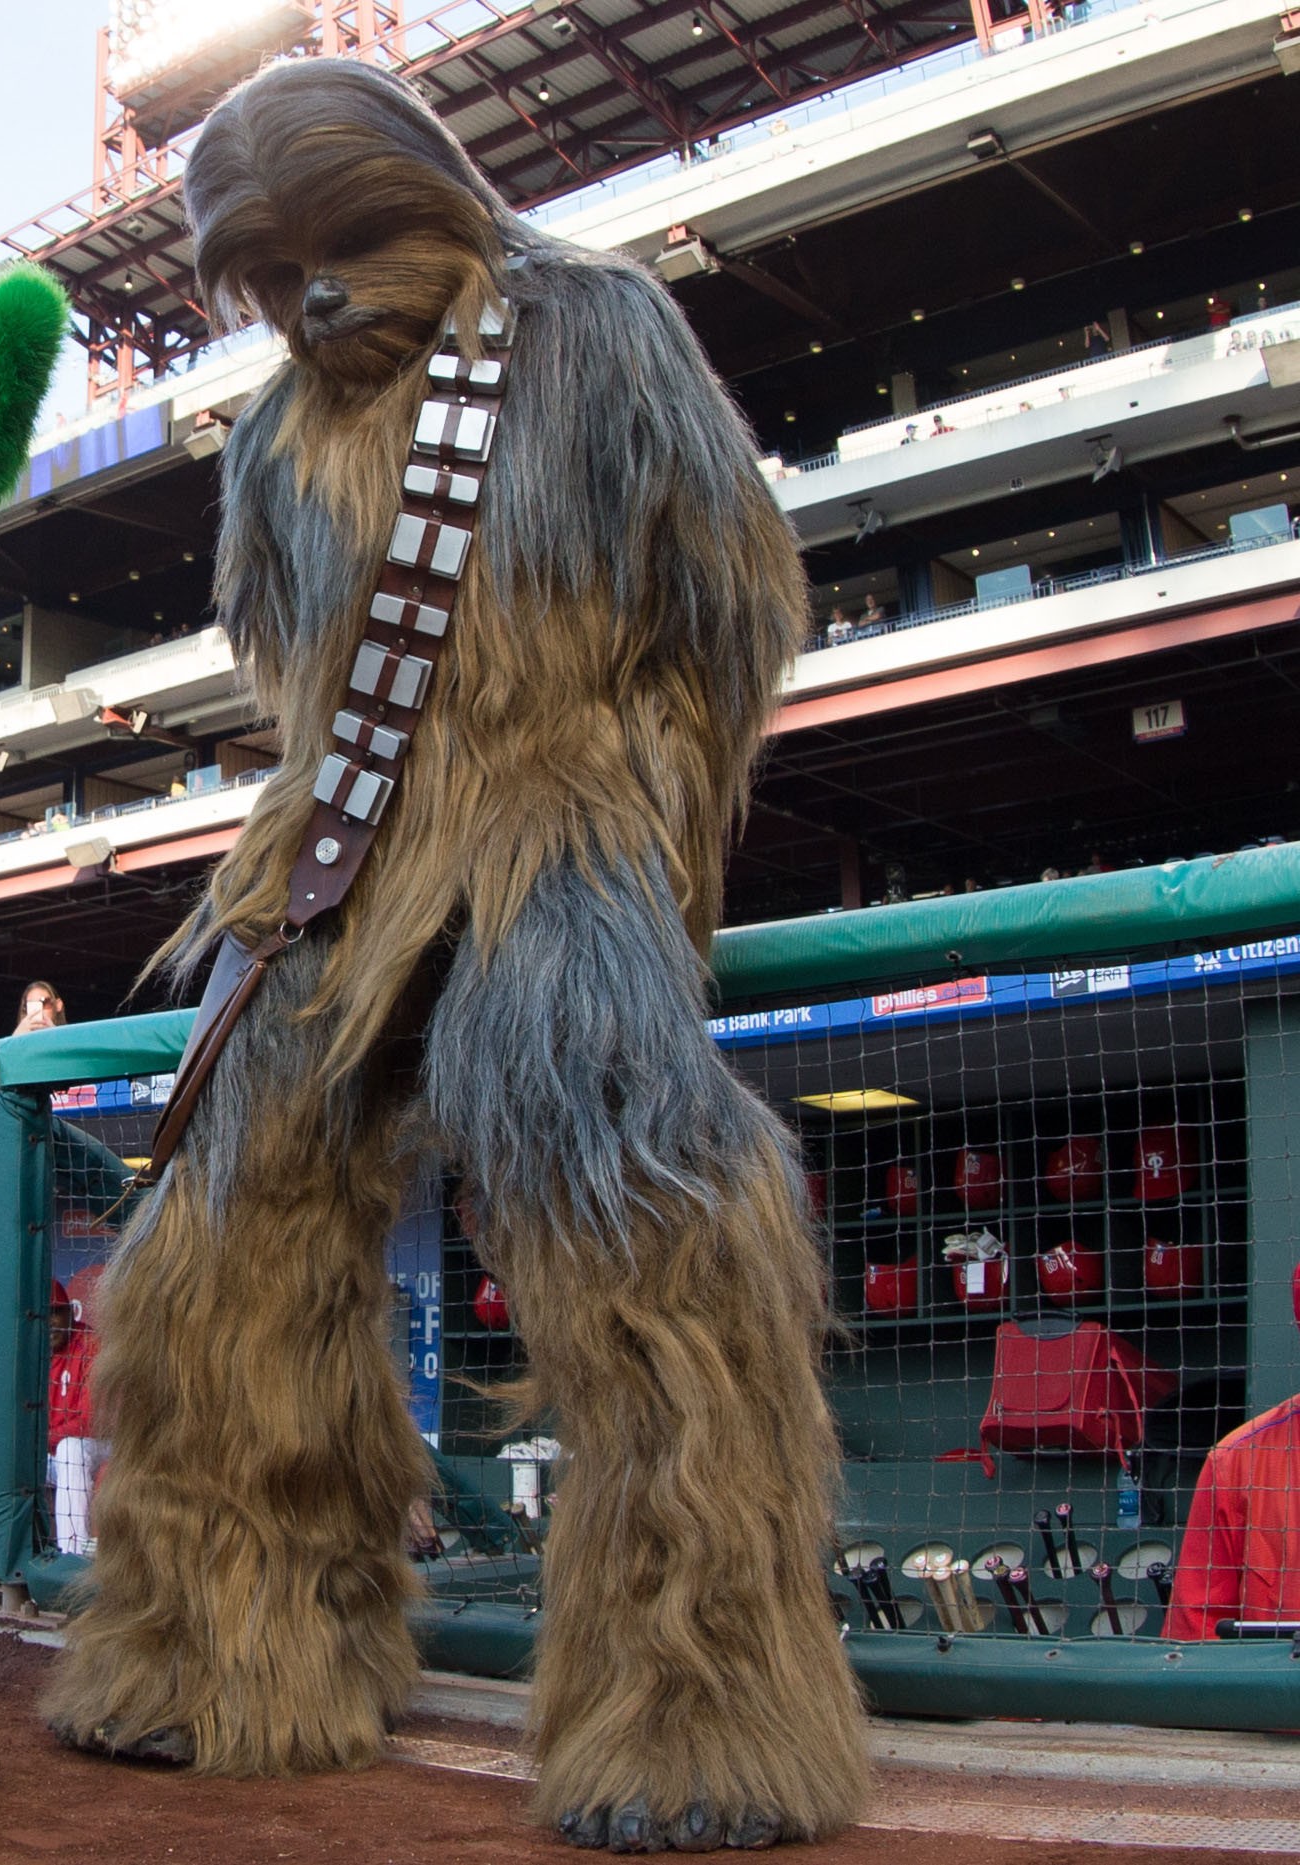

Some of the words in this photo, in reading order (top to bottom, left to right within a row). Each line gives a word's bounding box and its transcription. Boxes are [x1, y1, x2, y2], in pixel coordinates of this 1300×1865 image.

[1146, 705, 1170, 729] 117
[1228, 936, 1300, 961] Citizen
[1094, 968, 1122, 983] ERA
[877, 983, 981, 1012] phillies.com
[728, 1012, 771, 1032] Bank
[774, 1006, 813, 1026] Park
[1147, 1155, 1164, 1178] P
